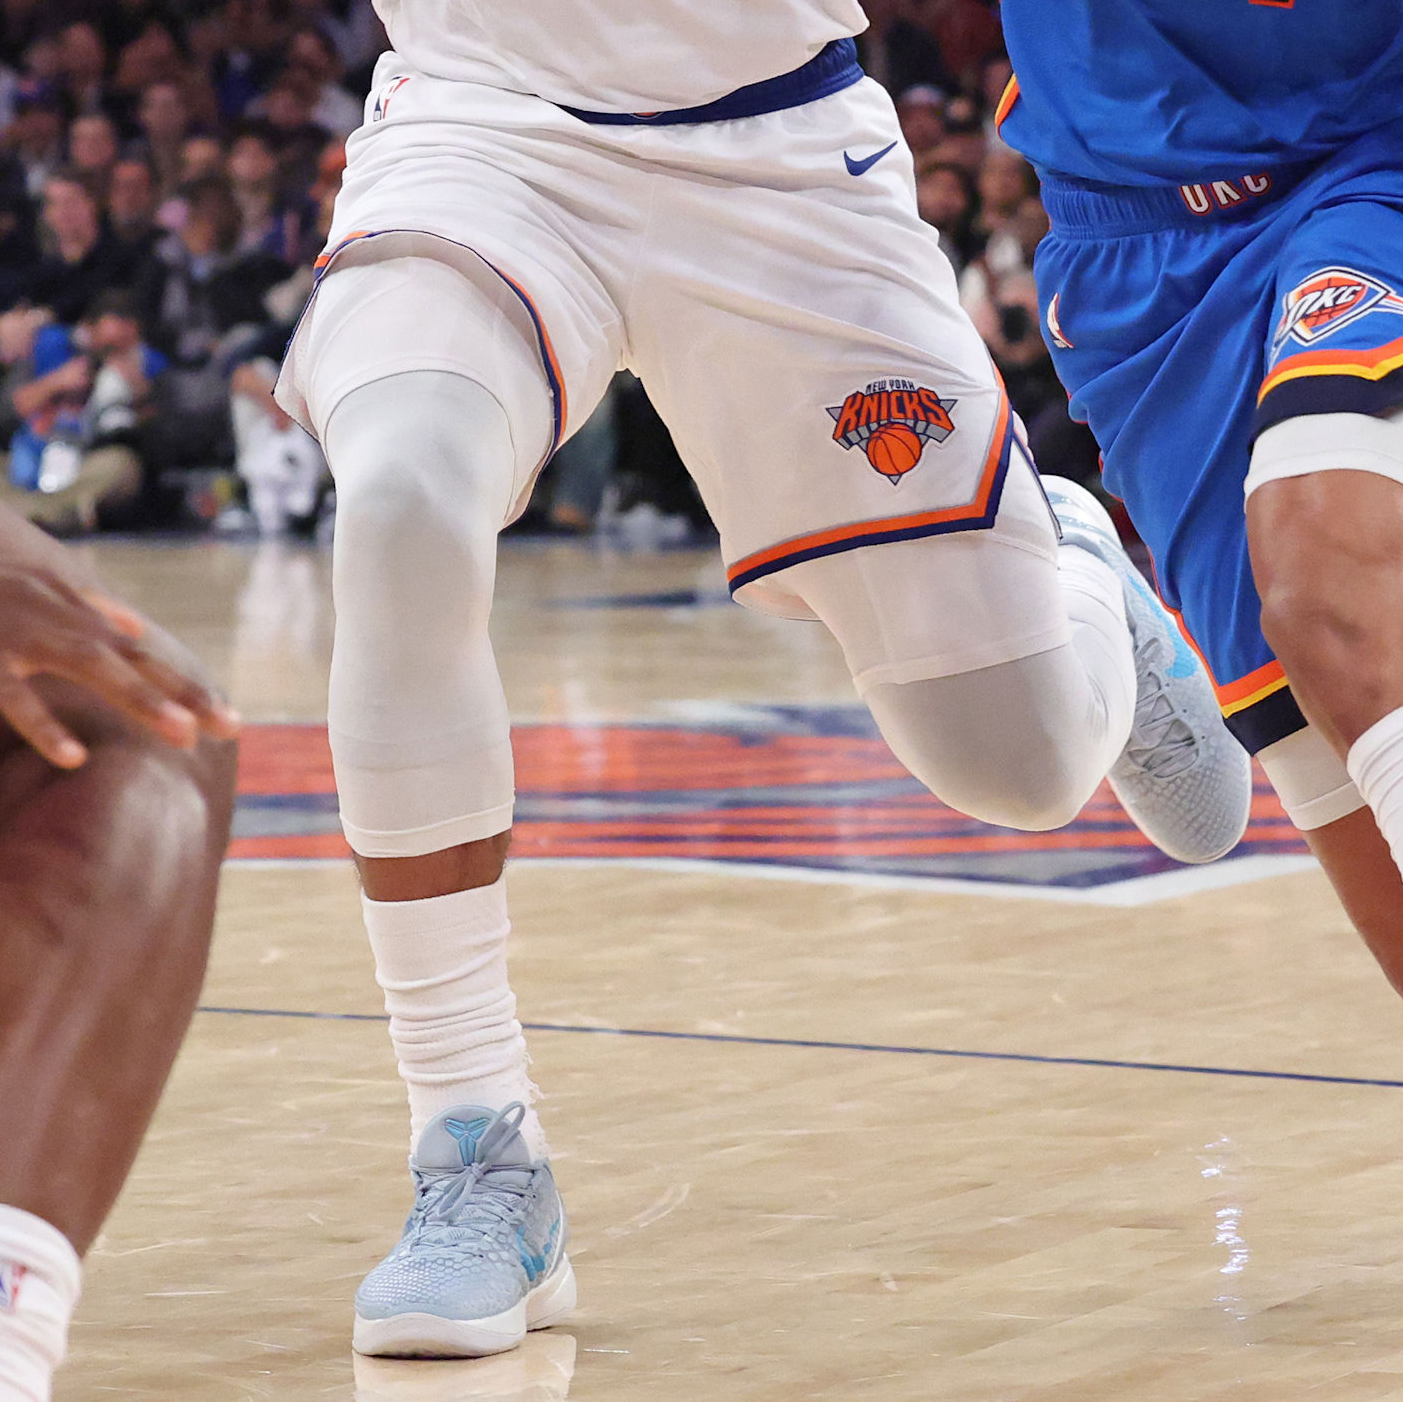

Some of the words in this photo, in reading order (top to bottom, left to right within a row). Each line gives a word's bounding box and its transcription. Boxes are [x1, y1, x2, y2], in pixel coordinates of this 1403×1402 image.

[865, 379, 888, 394] NEW
[889, 378, 916, 391] YORK
[832, 386, 956, 442] KNICKS
